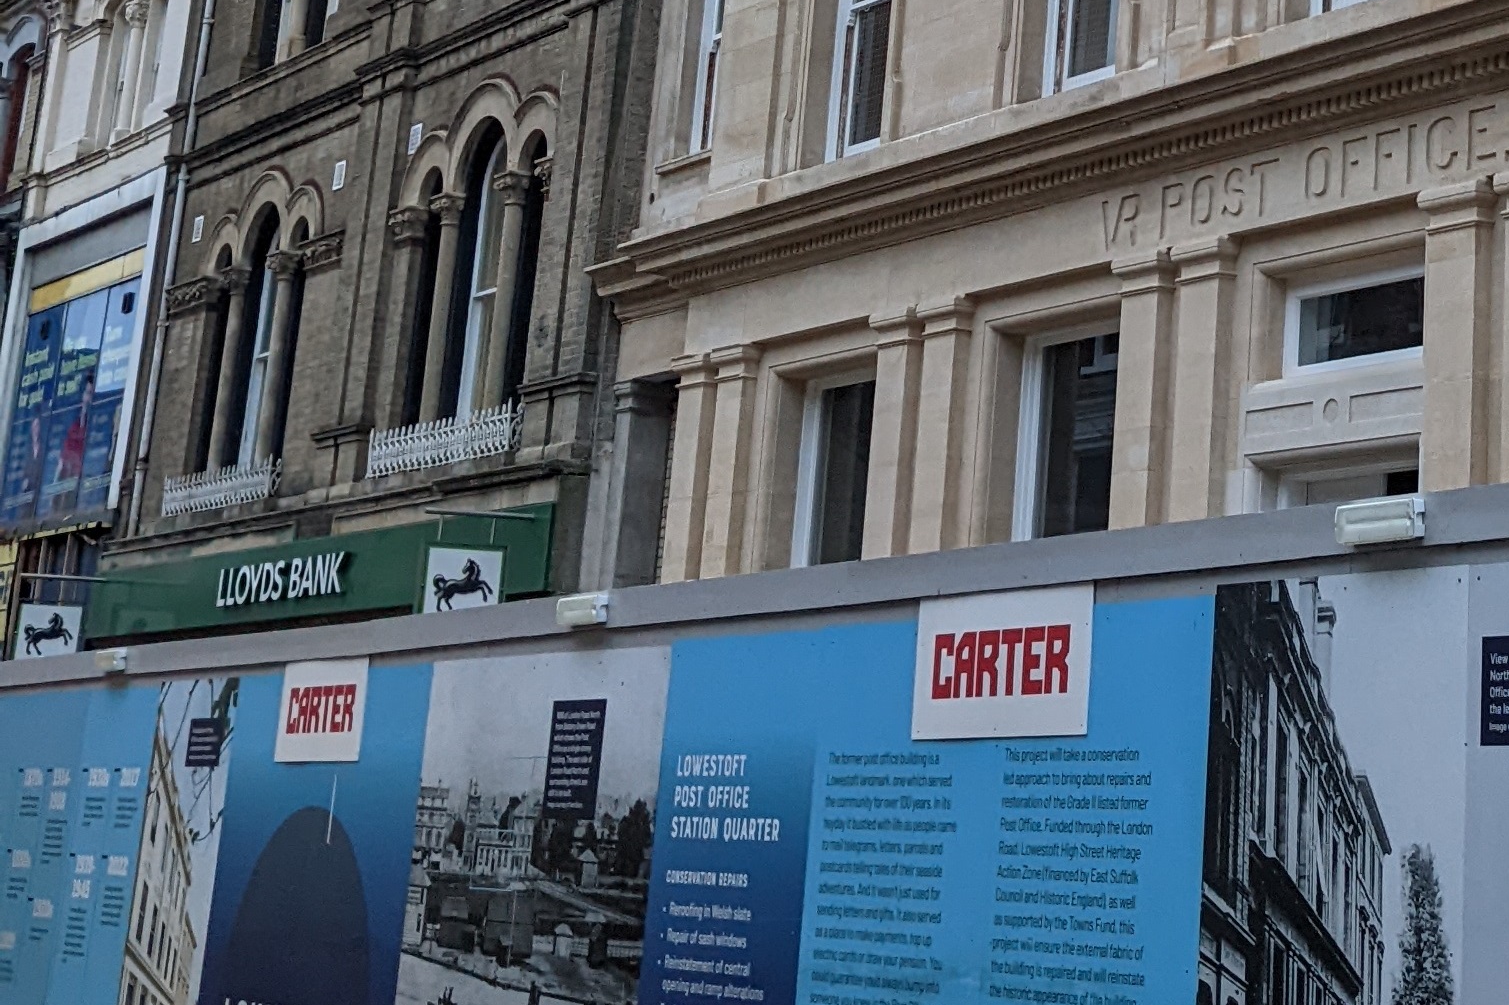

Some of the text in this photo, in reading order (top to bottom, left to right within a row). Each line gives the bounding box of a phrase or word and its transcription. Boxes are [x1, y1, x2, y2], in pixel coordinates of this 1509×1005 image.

[1160, 156, 1280, 240] POST
[216, 551, 345, 607] LLOYDS BANK
[932, 624, 1071, 699] CARTER
[1490, 652, 1508, 664] View
[286, 684, 357, 734] CARTER
[1489, 703, 1501, 715] the
[677, 754, 747, 777] LOWESTOFT
[1005, 748, 1020, 762] This
[1021, 749, 1048, 765] project
[1063, 749, 1080, 762] take
[1081, 751, 1087, 762] a
[1087, 747, 1139, 762] conservation
[1014, 773, 1050, 788] approach
[1052, 774, 1061, 786] to
[1061, 772, 1081, 789] bring
[1082, 772, 1105, 786] about
[1106, 772, 1135, 789] repairs
[1135, 772, 1151, 786] and
[674, 785, 750, 809] POST OFFICE
[1042, 796, 1052, 808] of
[1053, 796, 1066, 808] the
[1067, 795, 1090, 810] Grade
[1120, 796, 1149, 811] former
[671, 816, 780, 842] STATION QUARTER
[1000, 817, 1017, 832] Post
[1045, 819, 1073, 834] Funded
[1075, 820, 1106, 837] through
[1107, 821, 1120, 834] the
[1121, 821, 1153, 835] London
[1021, 843, 1060, 857] Lowestoft
[1061, 844, 1079, 860] High
[1081, 844, 1105, 859] Street
[1107, 845, 1141, 864] Heritage
[666, 869, 748, 888] CONSERVATION REPAIRS
[997, 865, 1021, 878] Action
[1022, 866, 1042, 880] Zone
[1080, 869, 1089, 885] by
[1090, 868, 1108, 884] East
[1110, 869, 1139, 885] Suffolk
[995, 888, 1023, 903] Council
[1024, 891, 1039, 903] and
[1040, 891, 1070, 905] Historic
[1109, 897, 1119, 908] as
[1119, 895, 1136, 910] well
[733, 906, 752, 922] slate
[1004, 915, 1043, 929] supported
[1044, 916, 1053, 932] by
[1054, 917, 1068, 930] the
[1069, 916, 1094, 931] Towns
[1119, 920, 1135, 935] this
[716, 931, 747, 949] windows
[992, 937, 1019, 953] project
[1034, 941, 1061, 954] ensure
[1062, 942, 1075, 956] the
[1076, 944, 1108, 958] external
[1109, 944, 1134, 960] fabric
[1135, 945, 1145, 961] of
[664, 954, 751, 977] Reinstatement of central
[991, 960, 1004, 973] the
[1004, 961, 1034, 979] building
[1043, 965, 1076, 981] repaired
[1077, 968, 1092, 981] and
[1108, 970, 1145, 986] reinstate
[661, 978, 690, 997] opening
[690, 981, 704, 995] and
[723, 983, 764, 1001] alterations
[1003, 985, 1031, 1000] historic
